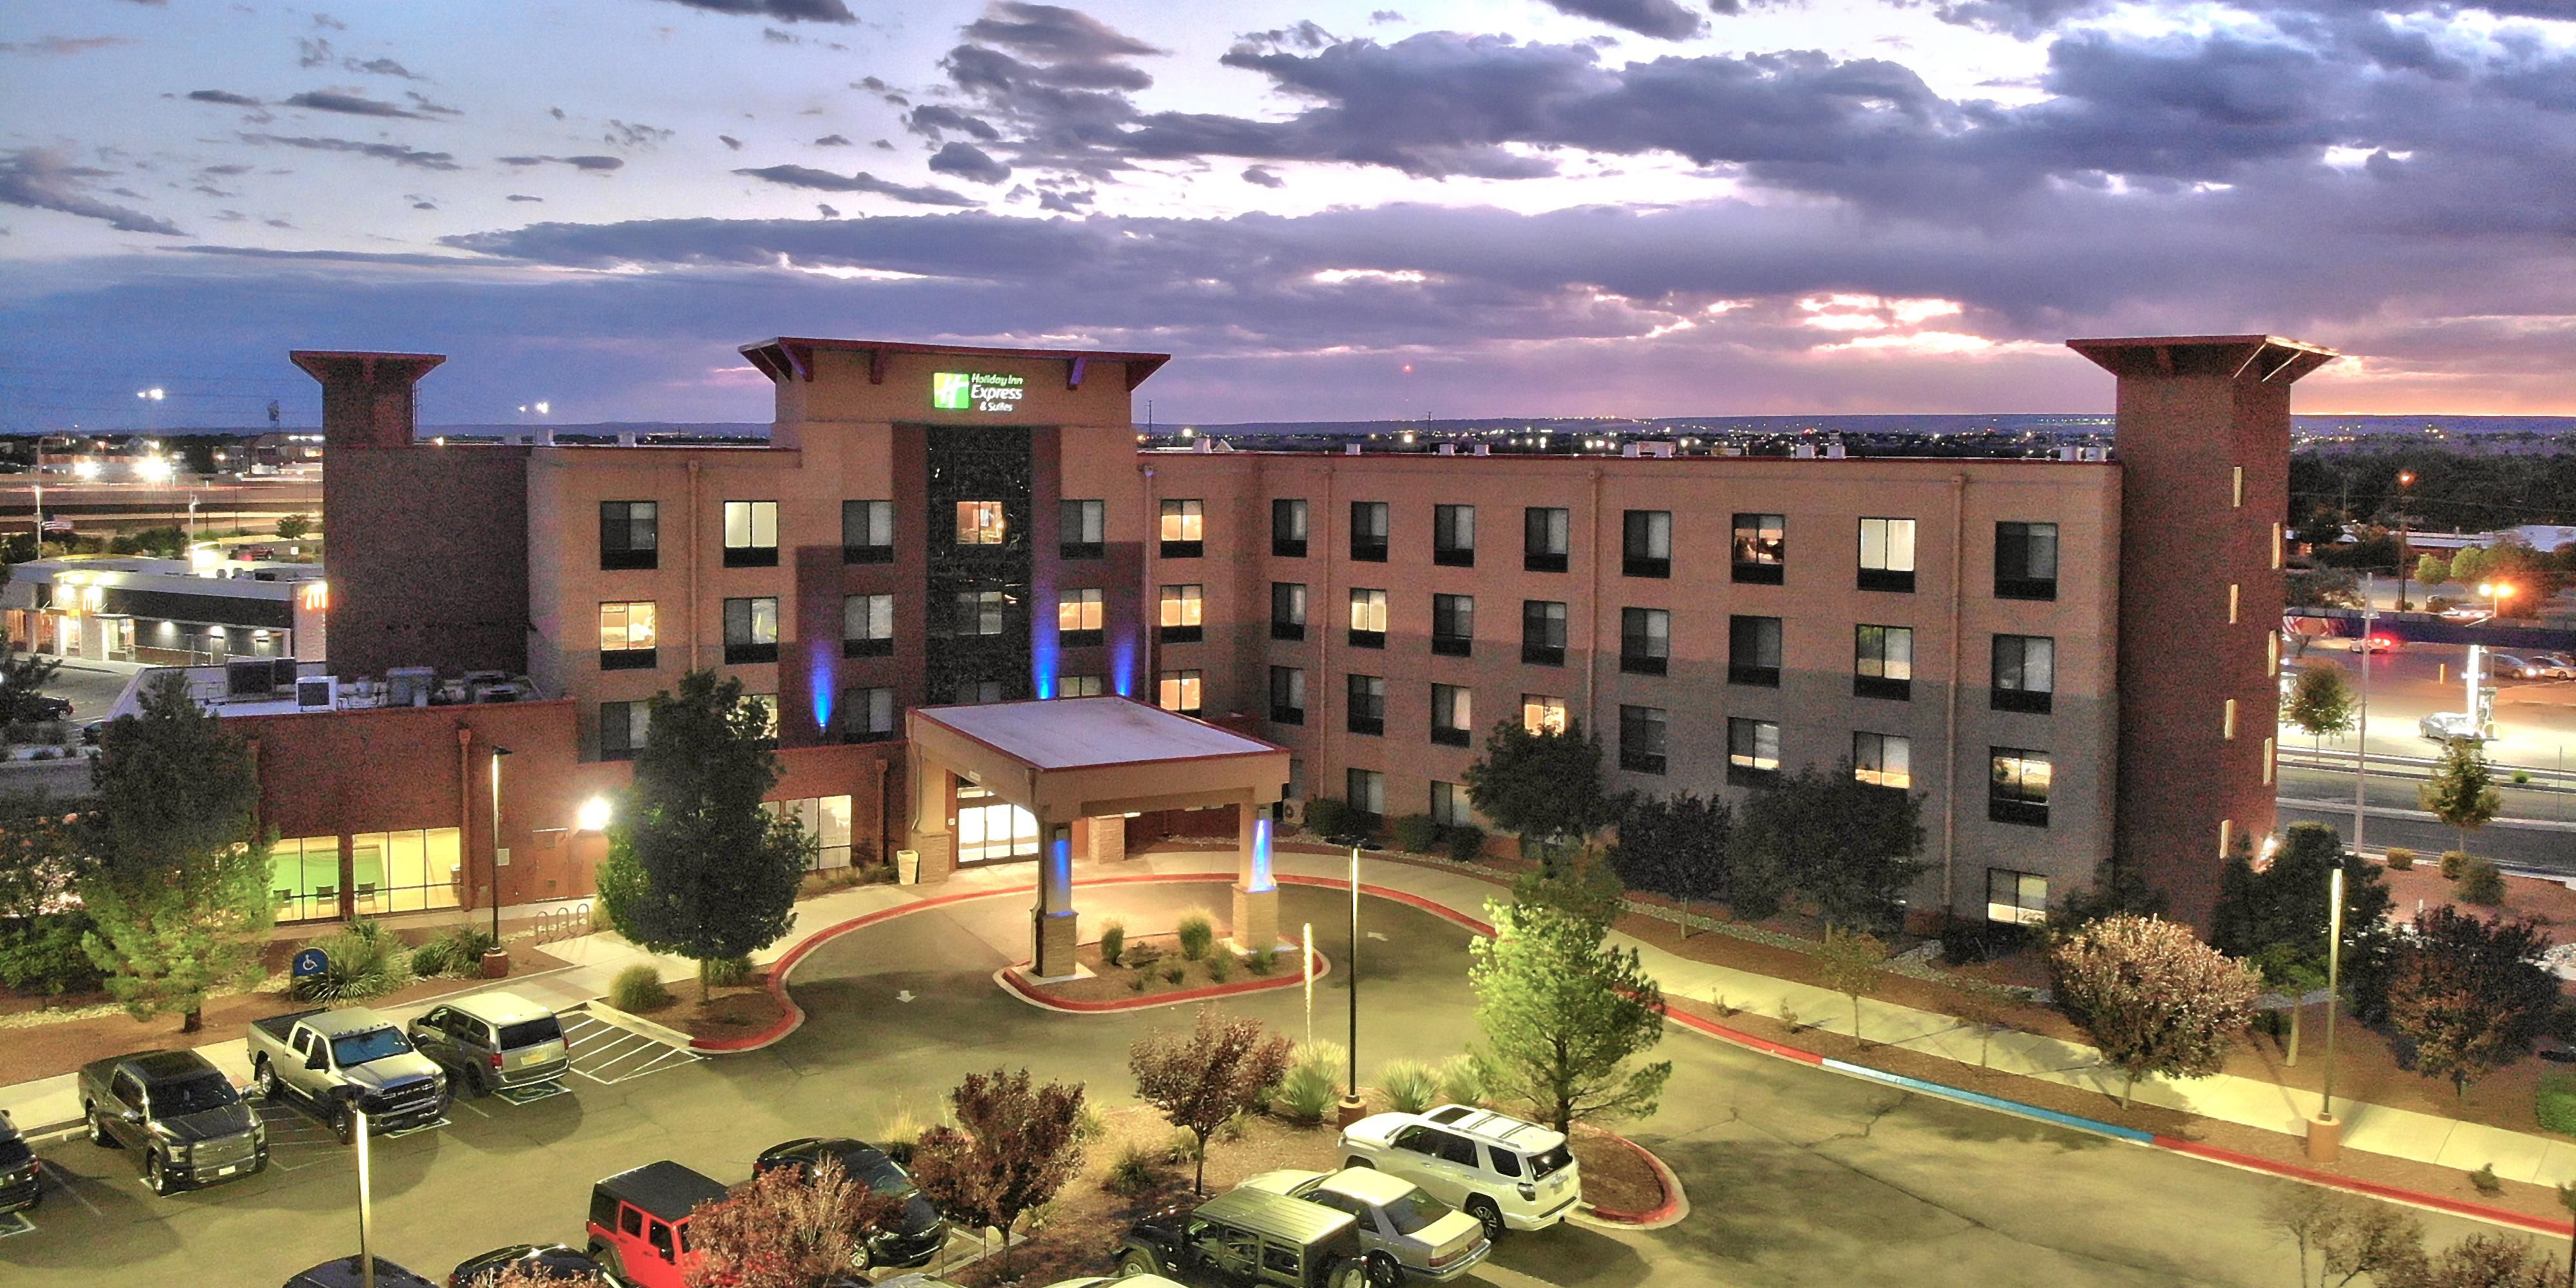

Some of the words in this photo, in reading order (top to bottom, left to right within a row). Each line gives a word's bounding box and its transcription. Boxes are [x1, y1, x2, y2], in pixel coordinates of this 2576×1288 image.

[971, 373, 1007, 386] Holiday
[1008, 374, 1023, 384] Inn
[971, 384, 1023, 402] Express
[980, 401, 987, 411] &
